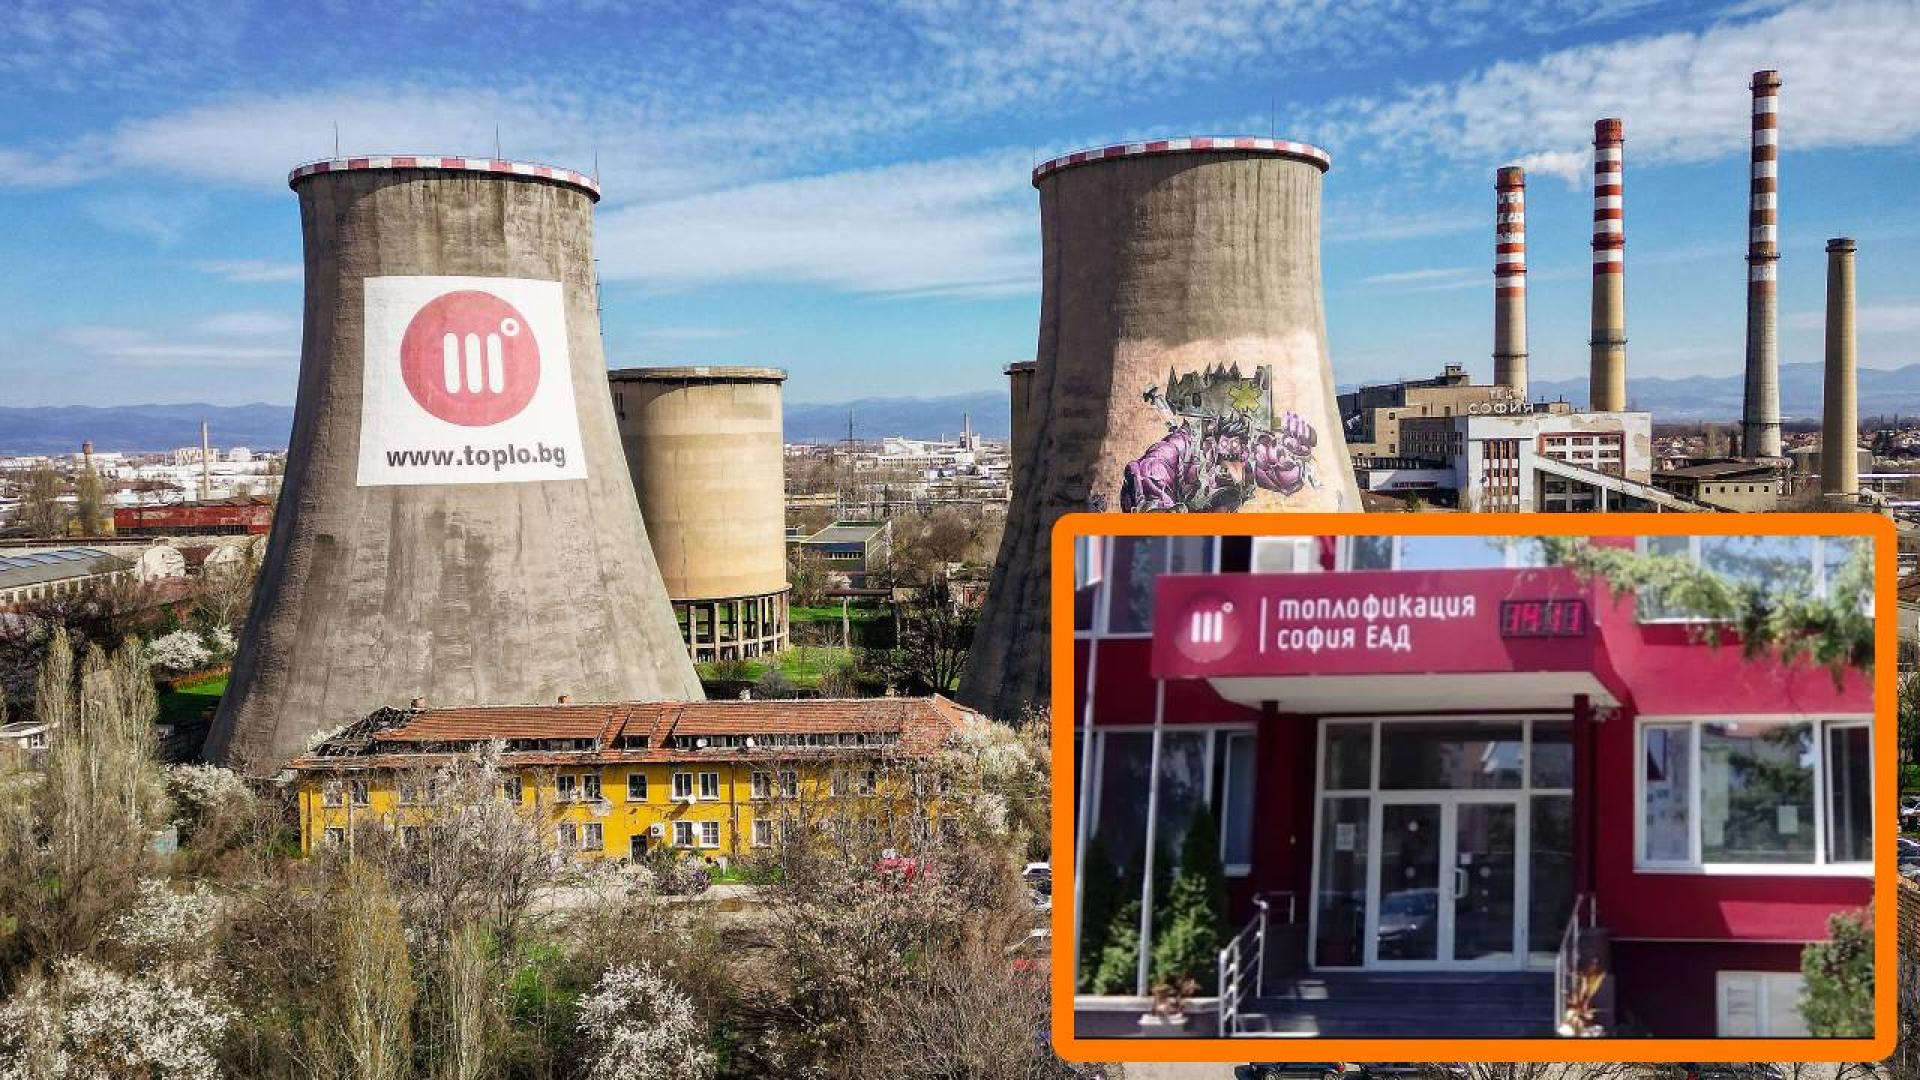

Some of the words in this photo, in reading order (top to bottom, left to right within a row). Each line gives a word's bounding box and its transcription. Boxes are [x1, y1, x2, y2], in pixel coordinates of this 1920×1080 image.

[1469, 403, 1534, 414] СОФИЯ
[387, 443, 566, 471] www.toplo.bg
[1279, 594, 1475, 621] топлофикация
[1277, 626, 1354, 653] софия
[1367, 624, 1411, 652] ЕАД
